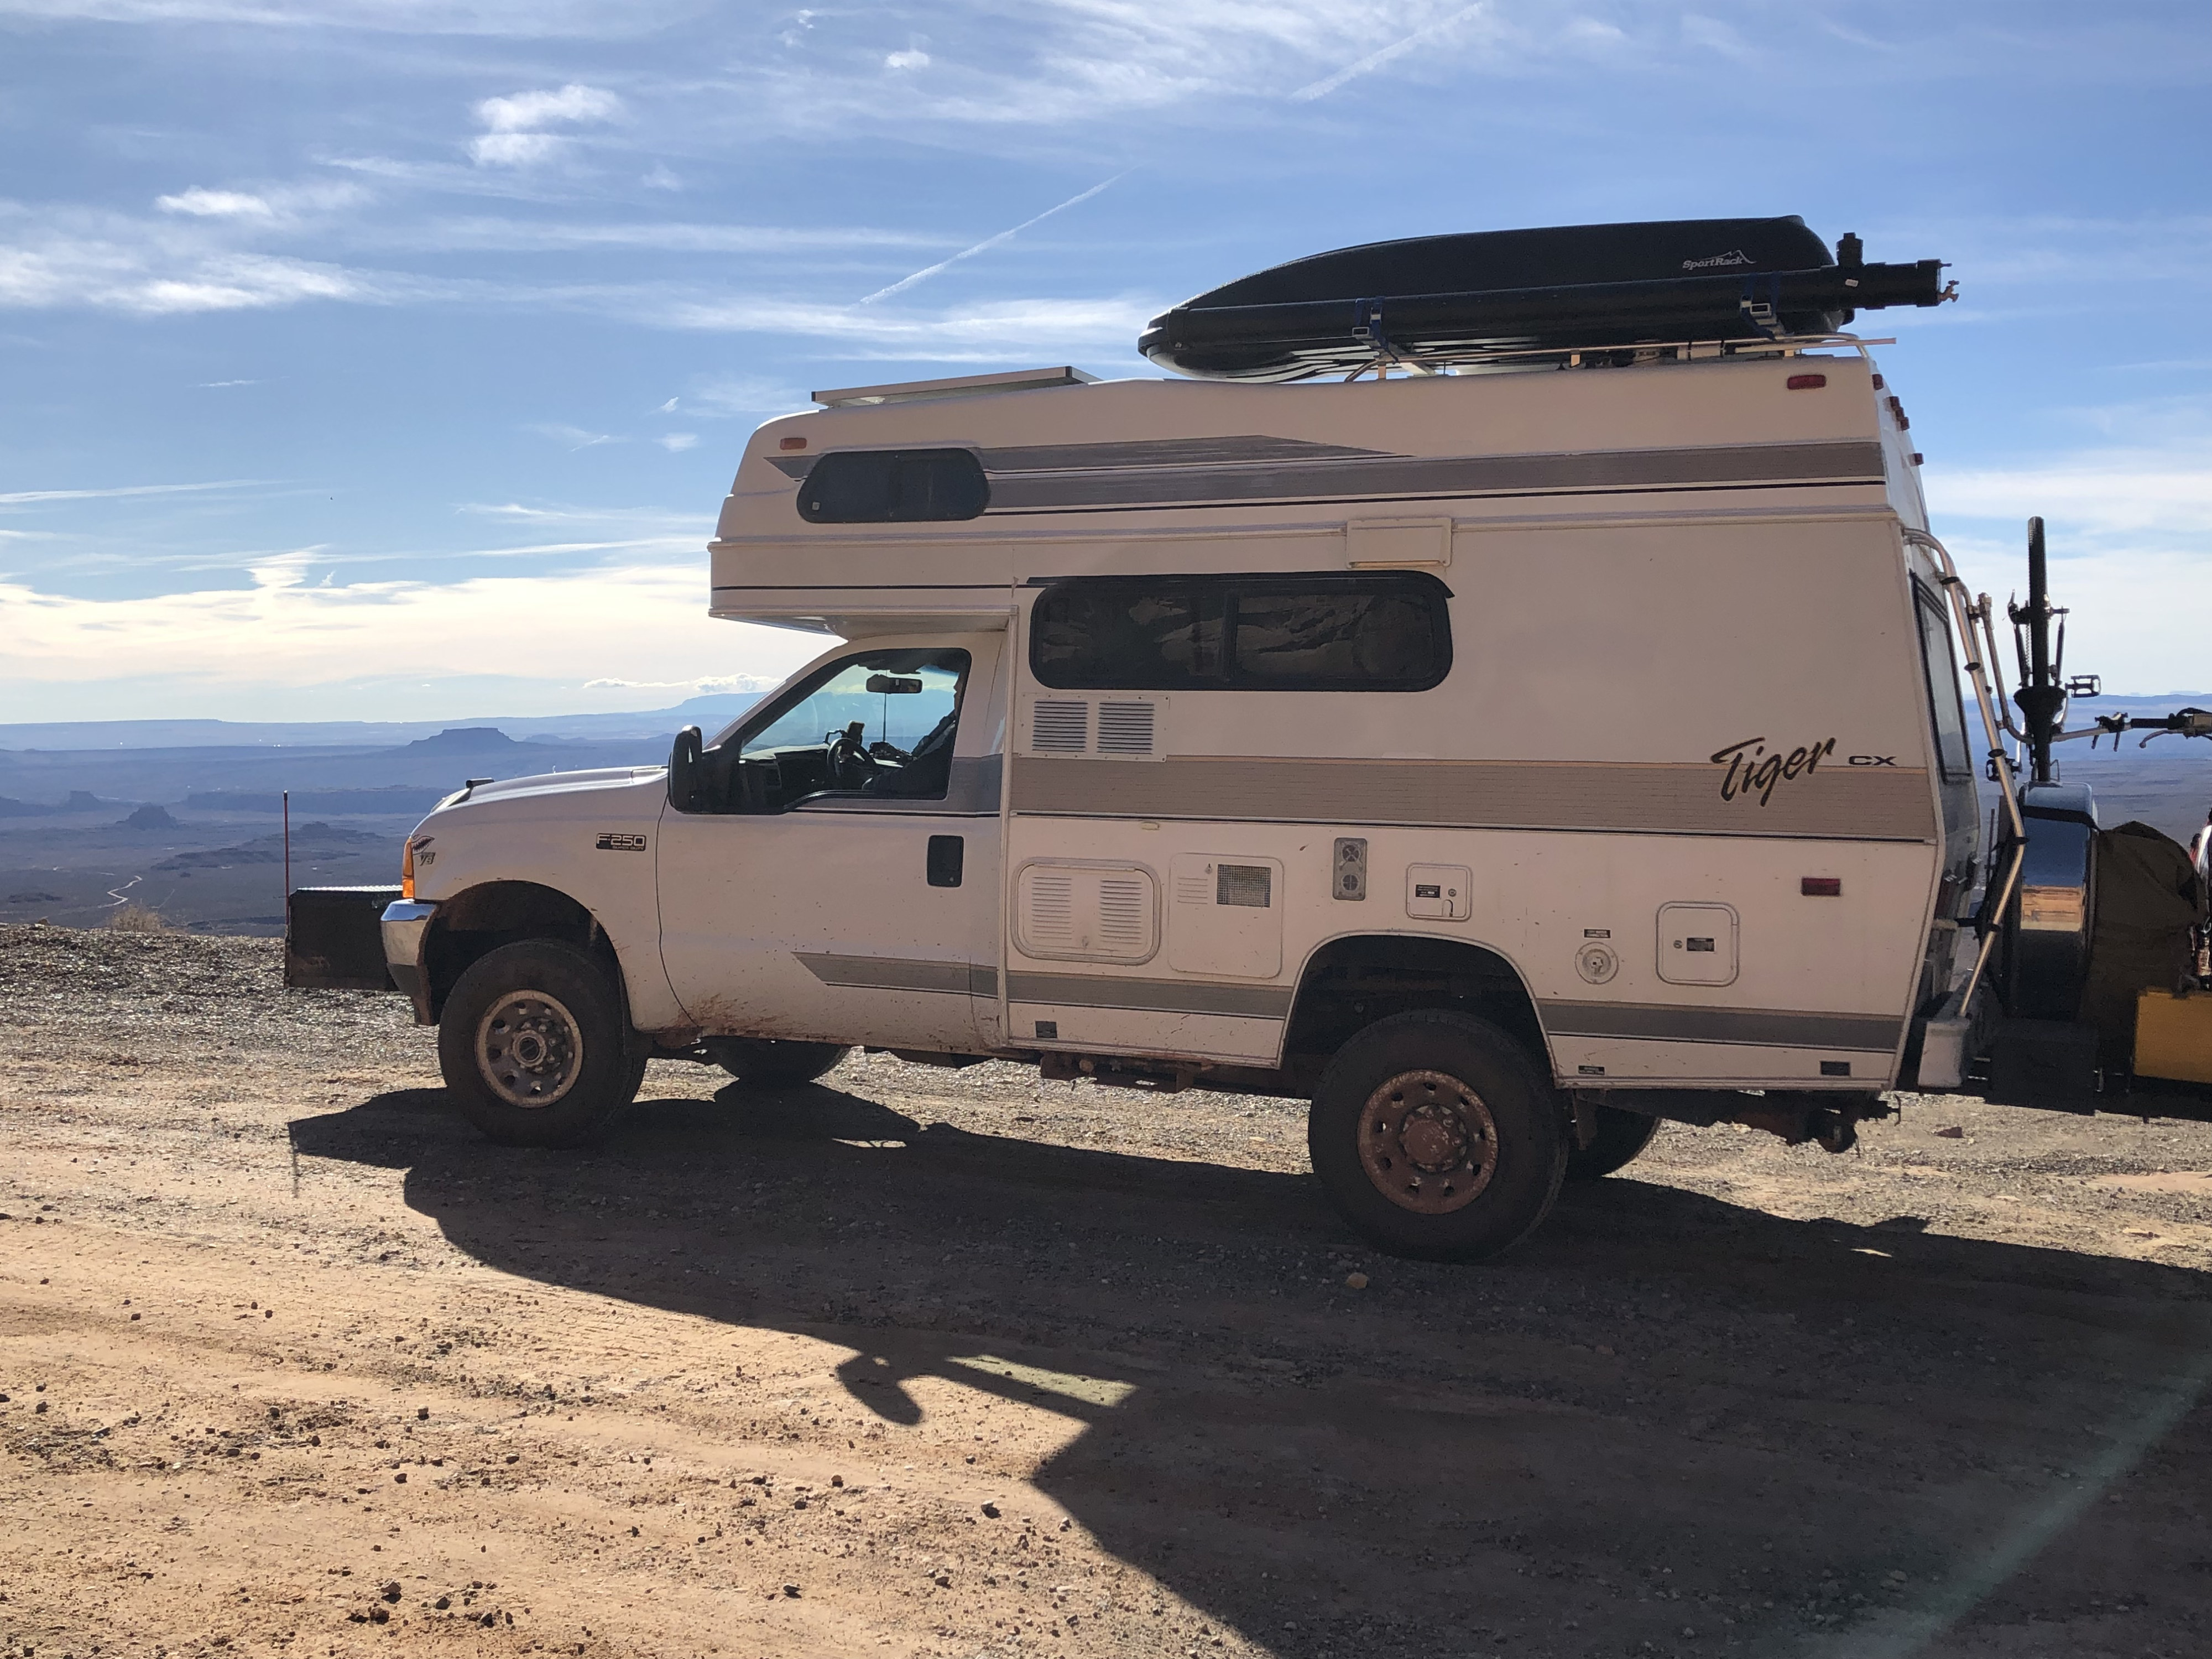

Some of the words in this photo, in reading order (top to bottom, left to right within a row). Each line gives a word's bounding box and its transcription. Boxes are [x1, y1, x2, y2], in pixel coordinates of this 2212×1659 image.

[1682, 257, 1743, 270] SportRack
[1711, 737, 1836, 807] Tiger
[1849, 755, 1897, 766] CX
